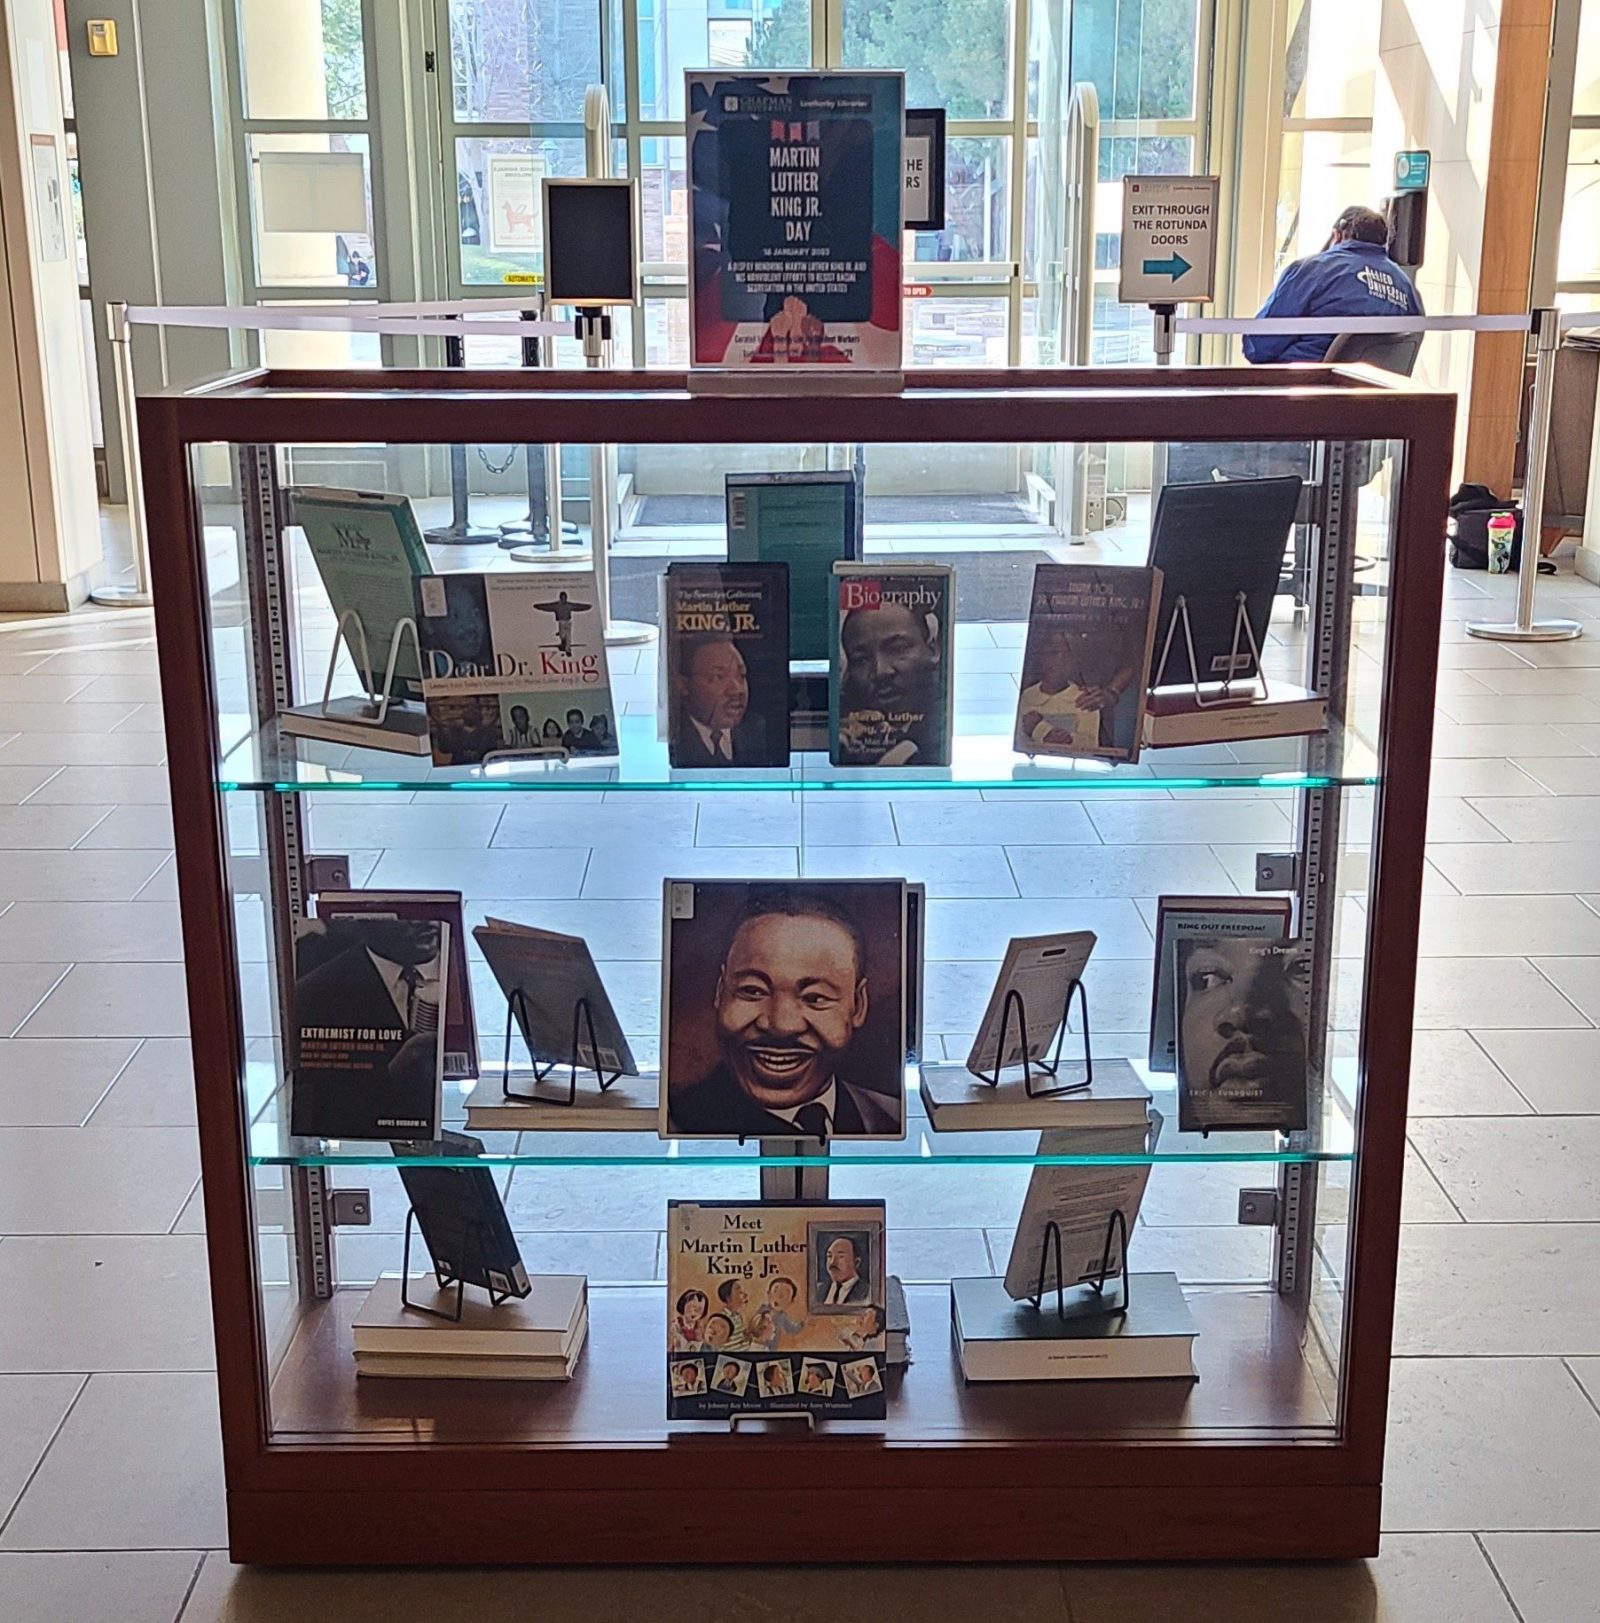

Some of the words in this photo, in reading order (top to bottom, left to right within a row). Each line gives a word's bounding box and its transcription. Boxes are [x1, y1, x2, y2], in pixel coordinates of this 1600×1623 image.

[769, 147, 820, 168] MARTIN
[771, 172, 819, 193] LUTHER
[771, 196, 802, 217] KING
[805, 196, 823, 217] JR.
[1132, 205, 1155, 215] EXIT
[1157, 205, 1210, 215] THROUGH
[786, 221, 812, 242] DAY
[1133, 220, 1153, 230] THE
[1155, 220, 1208, 230] ROTUNDA
[1151, 235, 1188, 245] DOORS
[773, 248, 809, 256] JANUARY
[1364, 266, 1394, 286] ALLIED
[913, 287, 927, 296] OPEN
[1367, 279, 1408, 305] UNIVERSAL
[846, 583, 942, 610] Biography
[677, 601, 713, 612] Martin
[715, 601, 752, 612] Luther
[677, 614, 731, 632] KING,
[733, 614, 760, 633] JR.
[428, 650, 490, 680] Dear
[496, 653, 533, 677] Dr.
[541, 651, 600, 683] King
[889, 712, 925, 722] Luther
[1221, 924, 1266, 932] FREEDOM!
[301, 1027, 355, 1040] EXTREMIST
[357, 1029, 376, 1040] FOR
[378, 1029, 402, 1040] LOVE
[724, 1214, 762, 1230] Meet
[680, 1238, 744, 1254] Martin
[750, 1235, 808, 1254] Luther
[707, 1256, 754, 1279] King
[760, 1256, 780, 1278] Jr.
